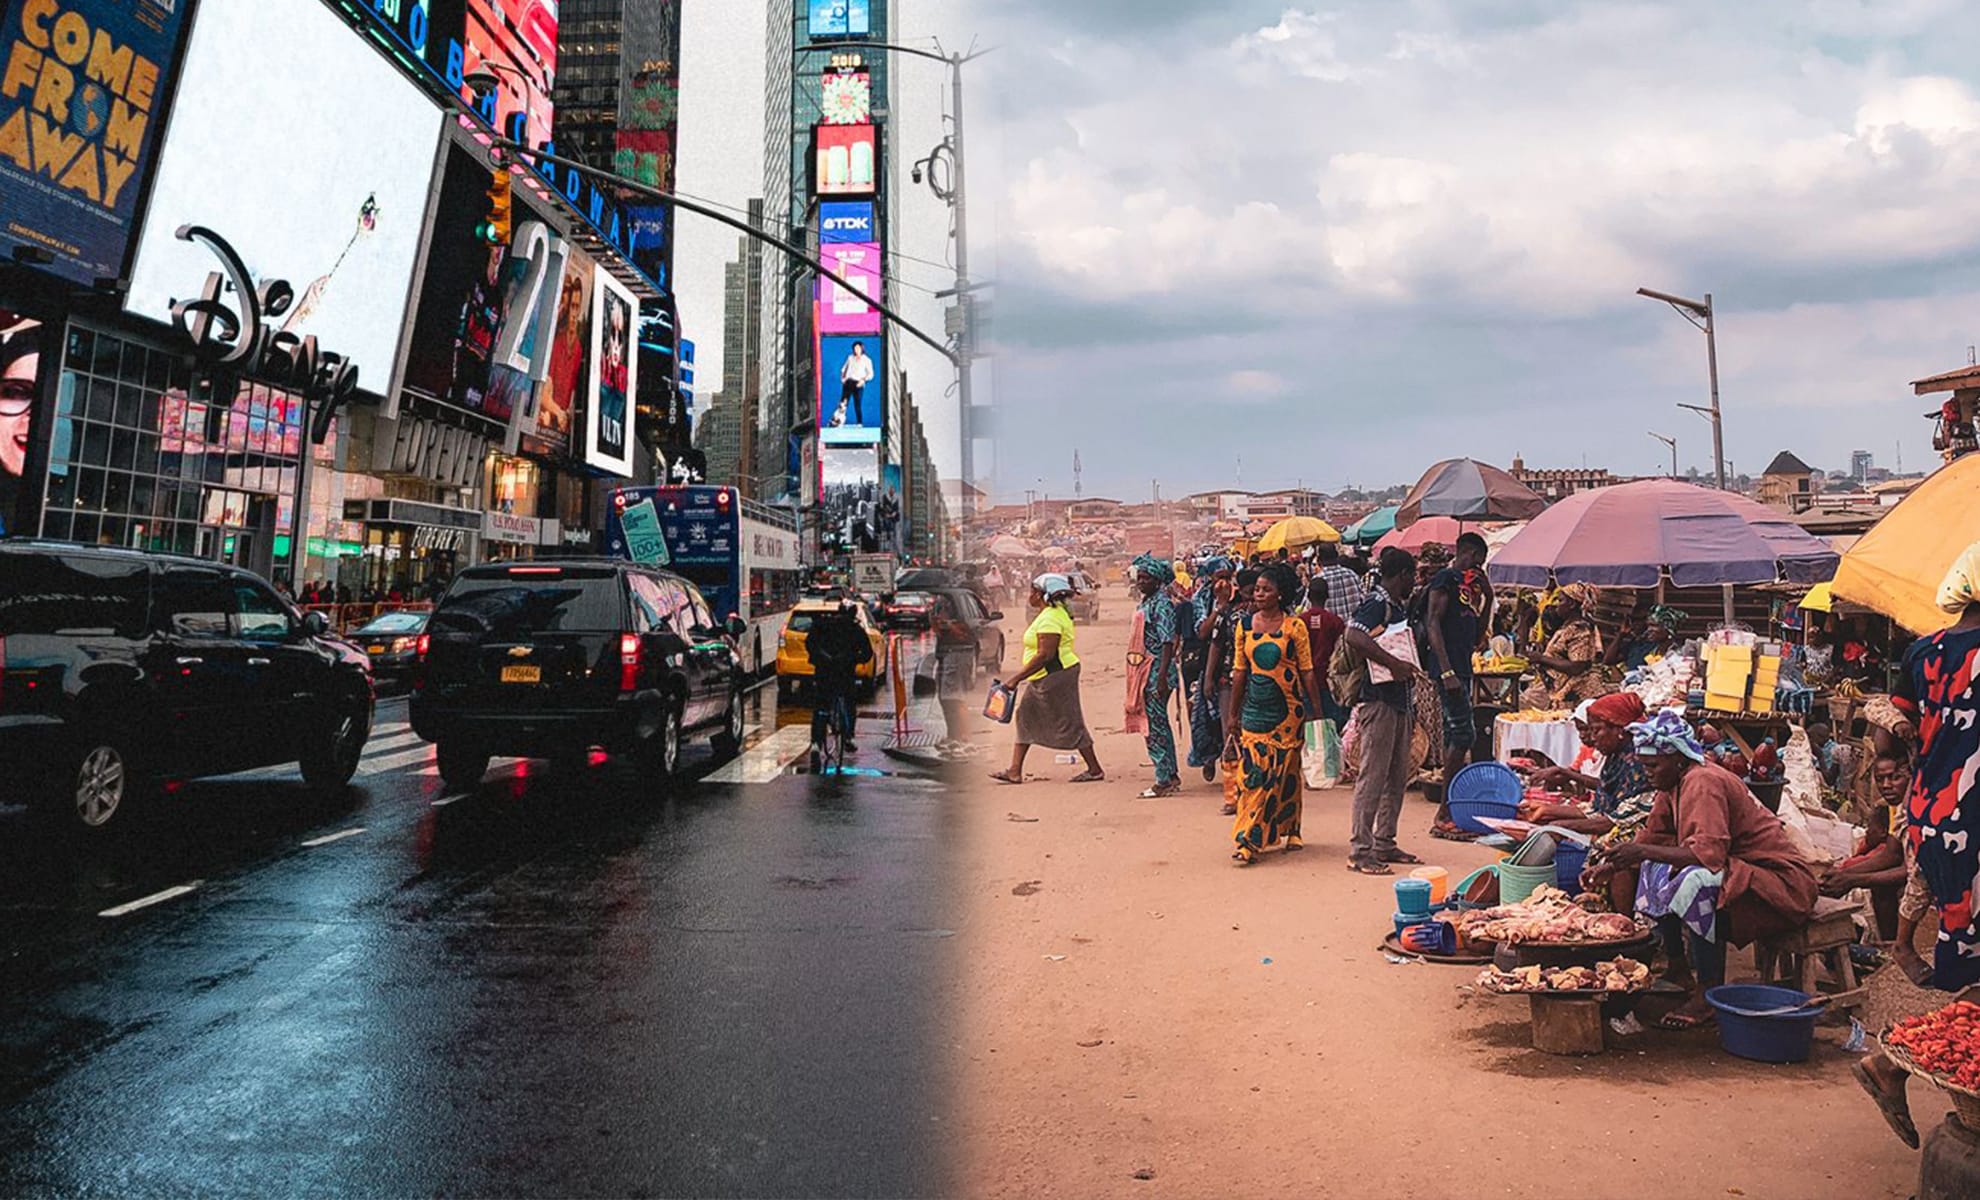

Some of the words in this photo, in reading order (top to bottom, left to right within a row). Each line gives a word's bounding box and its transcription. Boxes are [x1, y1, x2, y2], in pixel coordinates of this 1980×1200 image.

[2, 40, 148, 161] FROM
[22, 0, 160, 113] COME
[0, 106, 137, 208] AWAY
[835, 217, 868, 229] TDK
[392, 409, 488, 487] FOREVER
[411, 526, 454, 549] FOREVER
